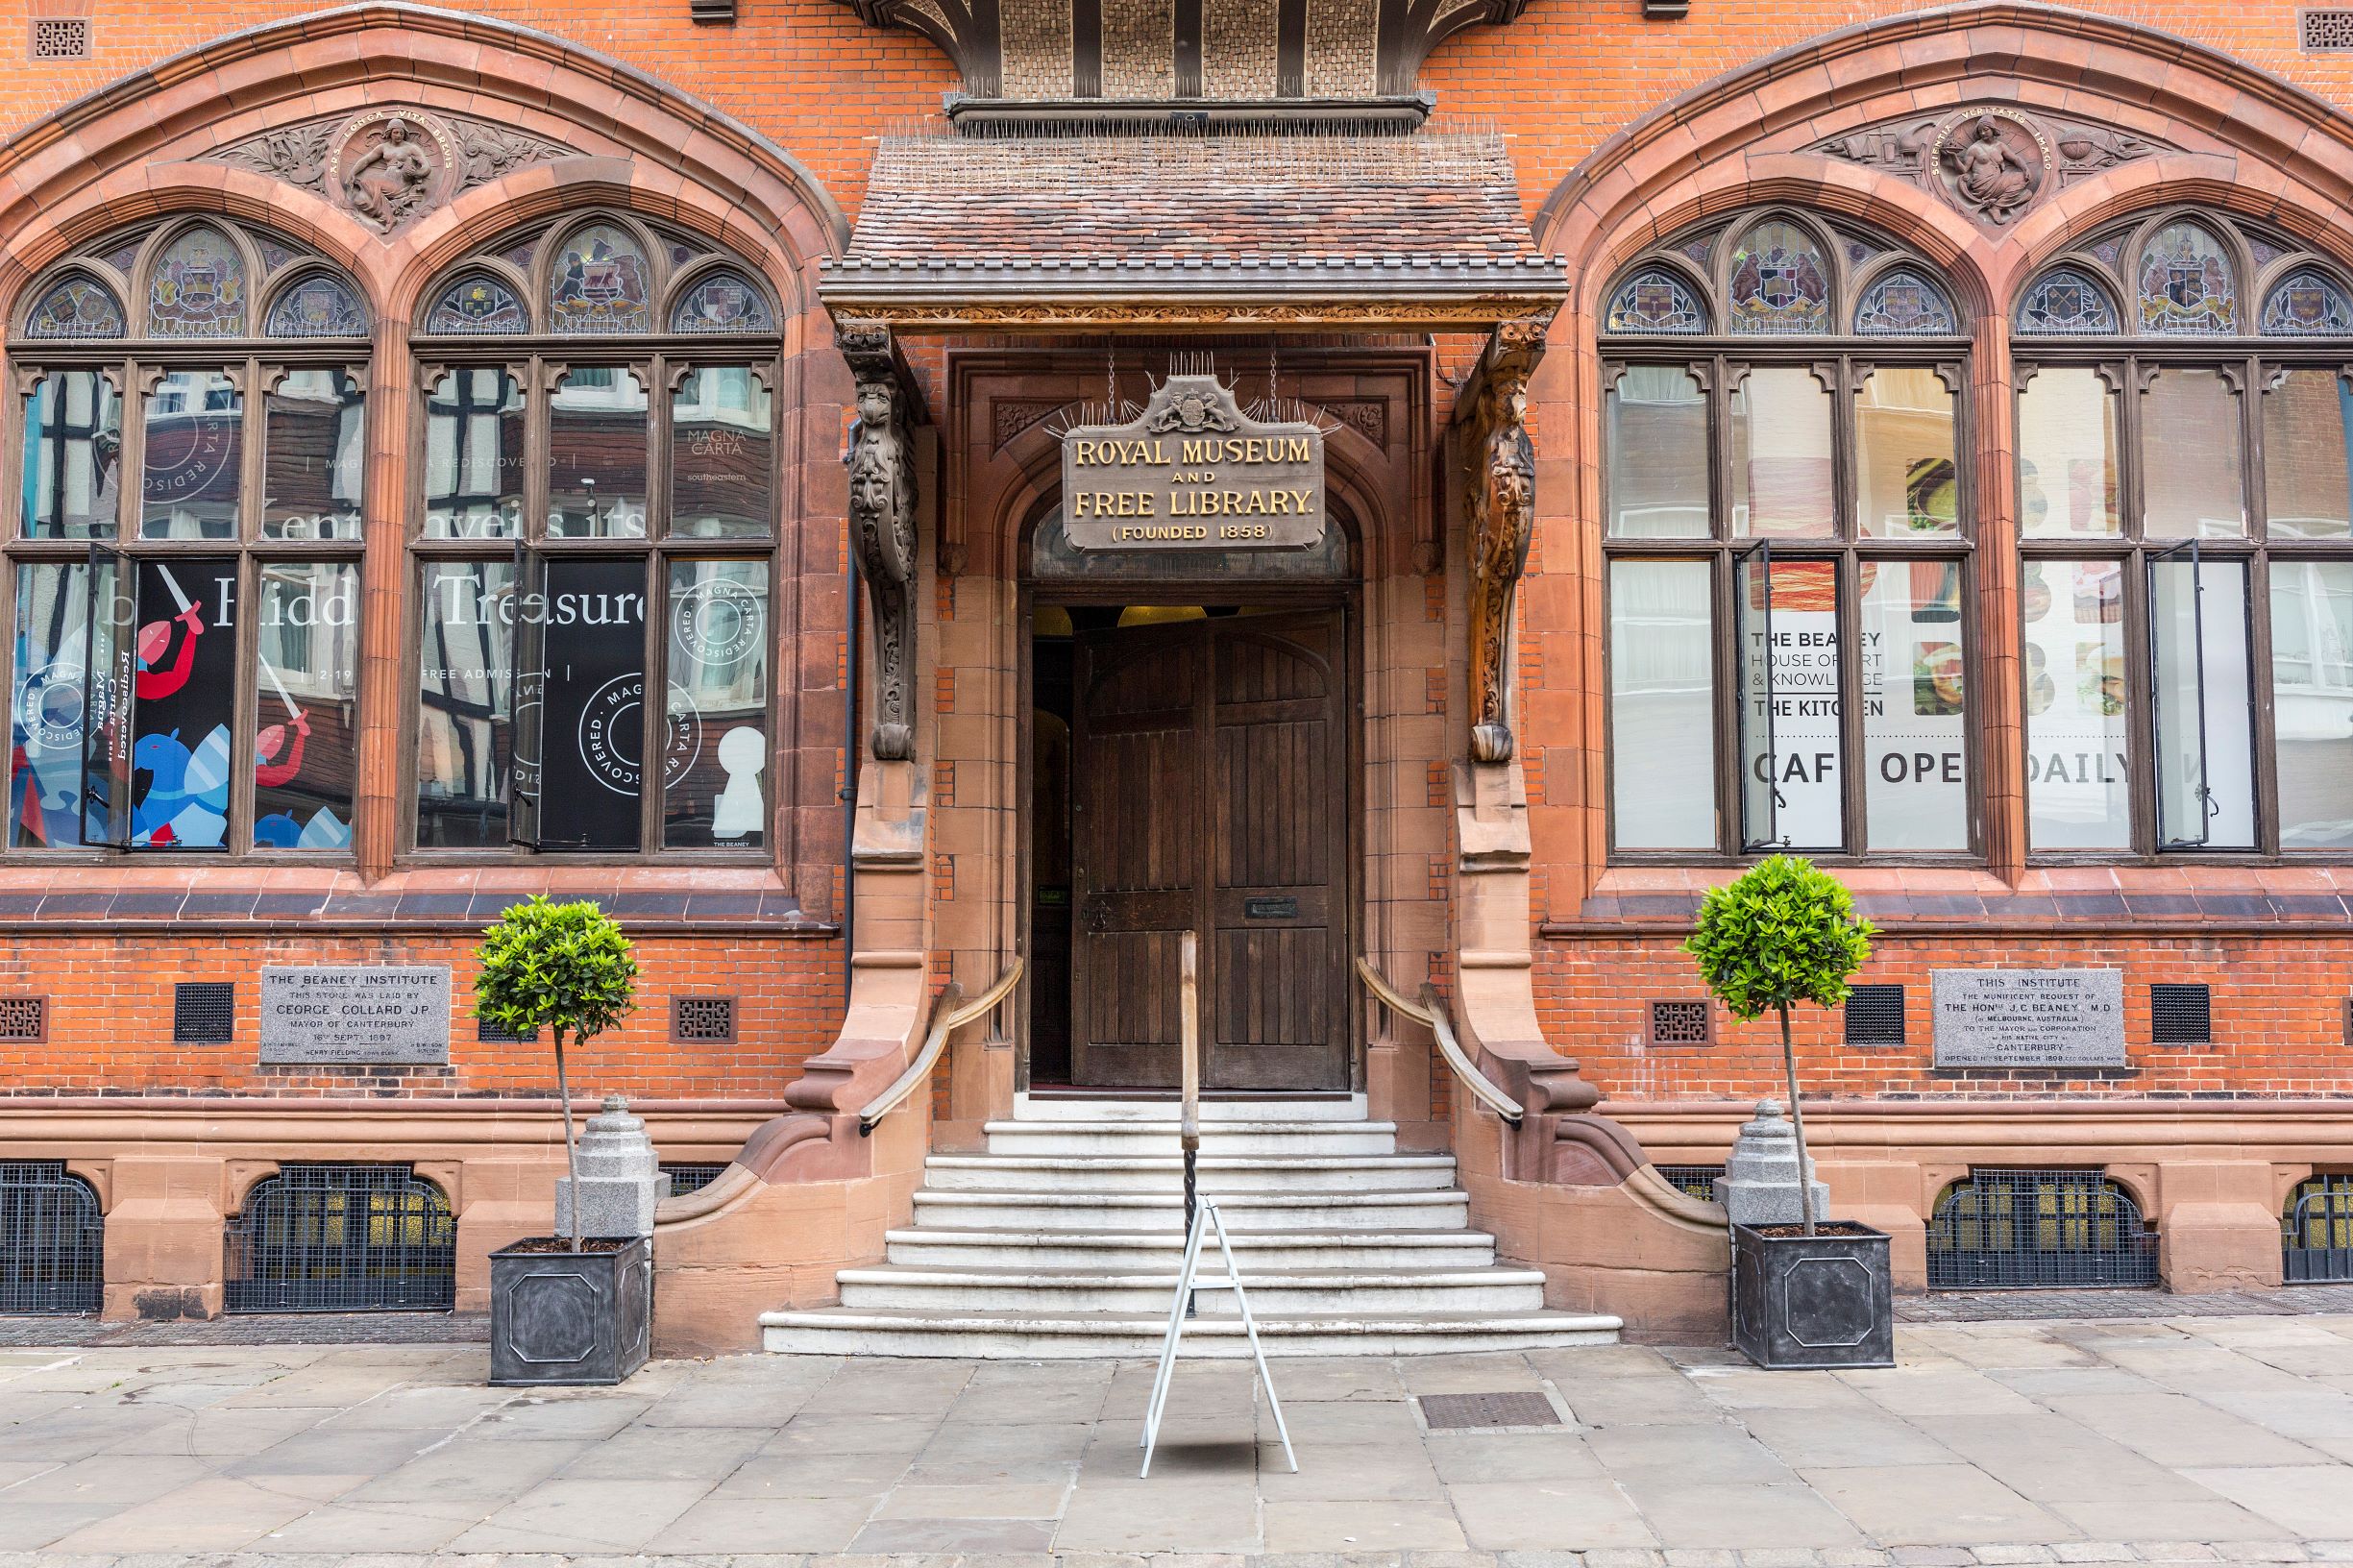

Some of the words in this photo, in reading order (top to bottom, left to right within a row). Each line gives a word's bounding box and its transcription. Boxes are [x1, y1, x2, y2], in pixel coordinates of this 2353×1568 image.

[343, 111, 383, 138] LONGA
[399, 110, 427, 125] VITA
[433, 129, 453, 169] BREVIS
[1961, 108, 2026, 124] VERITATIS
[2035, 132, 2051, 170] IMAGO
[688, 429, 747, 442] MAGNA
[692, 443, 743, 455] CARTA
[1075, 439, 1171, 466] ROYAL
[1182, 438, 1311, 464] MUSEUM
[325, 458, 362, 469] MAG
[1171, 471, 1215, 483] AND
[1074, 491, 1155, 518] FREE
[1169, 490, 1314, 516] LIBRARY.
[585, 499, 646, 538] its
[1112, 526, 1207, 543] (FOUNDED
[1218, 525, 1273, 541] 1858)
[696, 586, 738, 601] MAGNA
[741, 600, 754, 634] CARTA
[1799, 632, 1881, 647] BEAEY
[1752, 654, 1812, 667] HOUSE
[1863, 654, 1881, 667] RT
[40, 671, 83, 684] MAGNA
[1752, 673, 1764, 686] &
[607, 684, 641, 704] MAG
[672, 702, 690, 750] CARTA
[1753, 752, 1834, 783] CAF
[1880, 752, 1962, 783] OPE
[269, 975, 295, 984] THE
[304, 975, 356, 984] BEANEY
[366, 975, 437, 984] INSTITUTE
[1976, 978, 2005, 987] THIS
[2018, 978, 2080, 987] INSTITUTE
[277, 1004, 330, 1015] GEORGE
[341, 1004, 402, 1015] COLLARD
